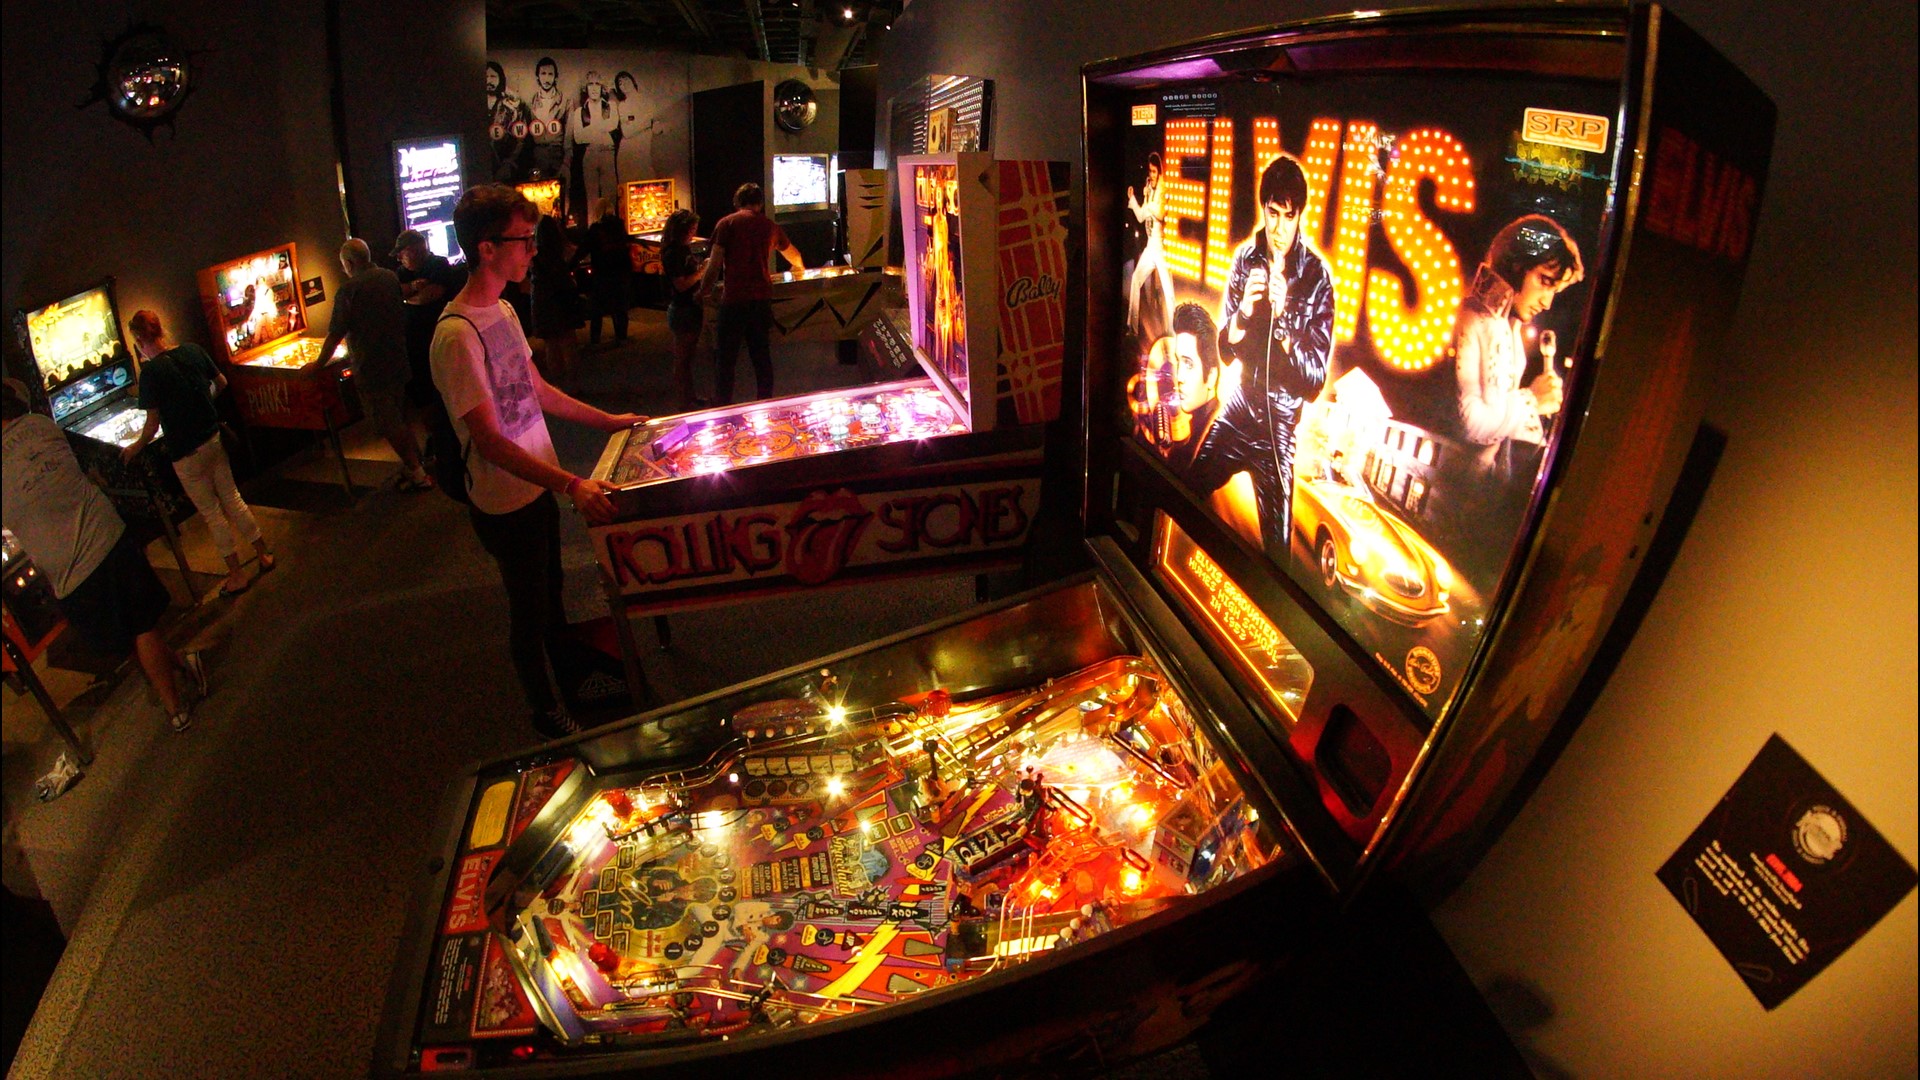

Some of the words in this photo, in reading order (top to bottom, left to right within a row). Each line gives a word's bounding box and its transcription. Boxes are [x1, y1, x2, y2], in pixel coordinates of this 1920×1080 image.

[514, 120, 560, 137] WHO
[1132, 106, 1154, 120] STERN
[1528, 113, 1604, 140] SRP
[1645, 126, 1757, 262] ELVIS
[1163, 116, 1477, 373] ELVIS
[1005, 275, 1062, 309] Bally
[248, 380, 292, 418] PUNK!
[605, 513, 783, 586] ROLLING
[878, 485, 1029, 553] STONES
[1188, 557, 1217, 592] HUMES
[1217, 591, 1242, 621] HIGH
[1242, 614, 1279, 663] SCHOOL
[1195, 550, 1223, 585] ELVIS
[1223, 580, 1281, 646] GRADUATED
[1210, 595, 1221, 614] IN
[831, 835, 857, 897] Graceland
[449, 857, 480, 929] ELVIS
[814, 906, 840, 915] SUPER
[891, 908, 918, 918] LOCK
[846, 935, 855, 947] UP
